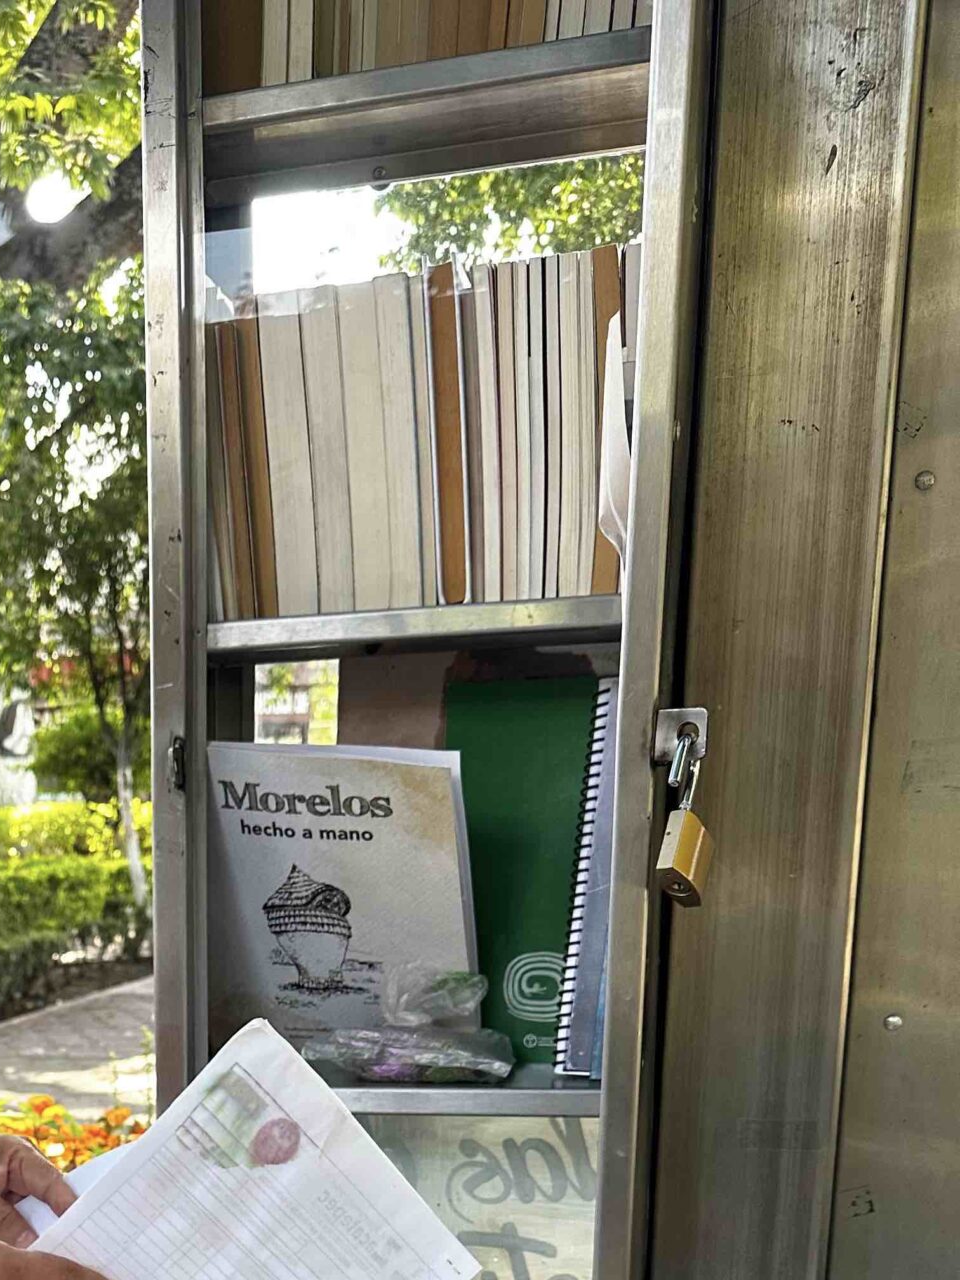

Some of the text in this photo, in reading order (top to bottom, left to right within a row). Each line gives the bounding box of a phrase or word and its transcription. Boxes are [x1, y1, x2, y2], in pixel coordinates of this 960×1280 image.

[218, 780, 394, 819] Morelos
[240, 820, 374, 843] hecho a mano
